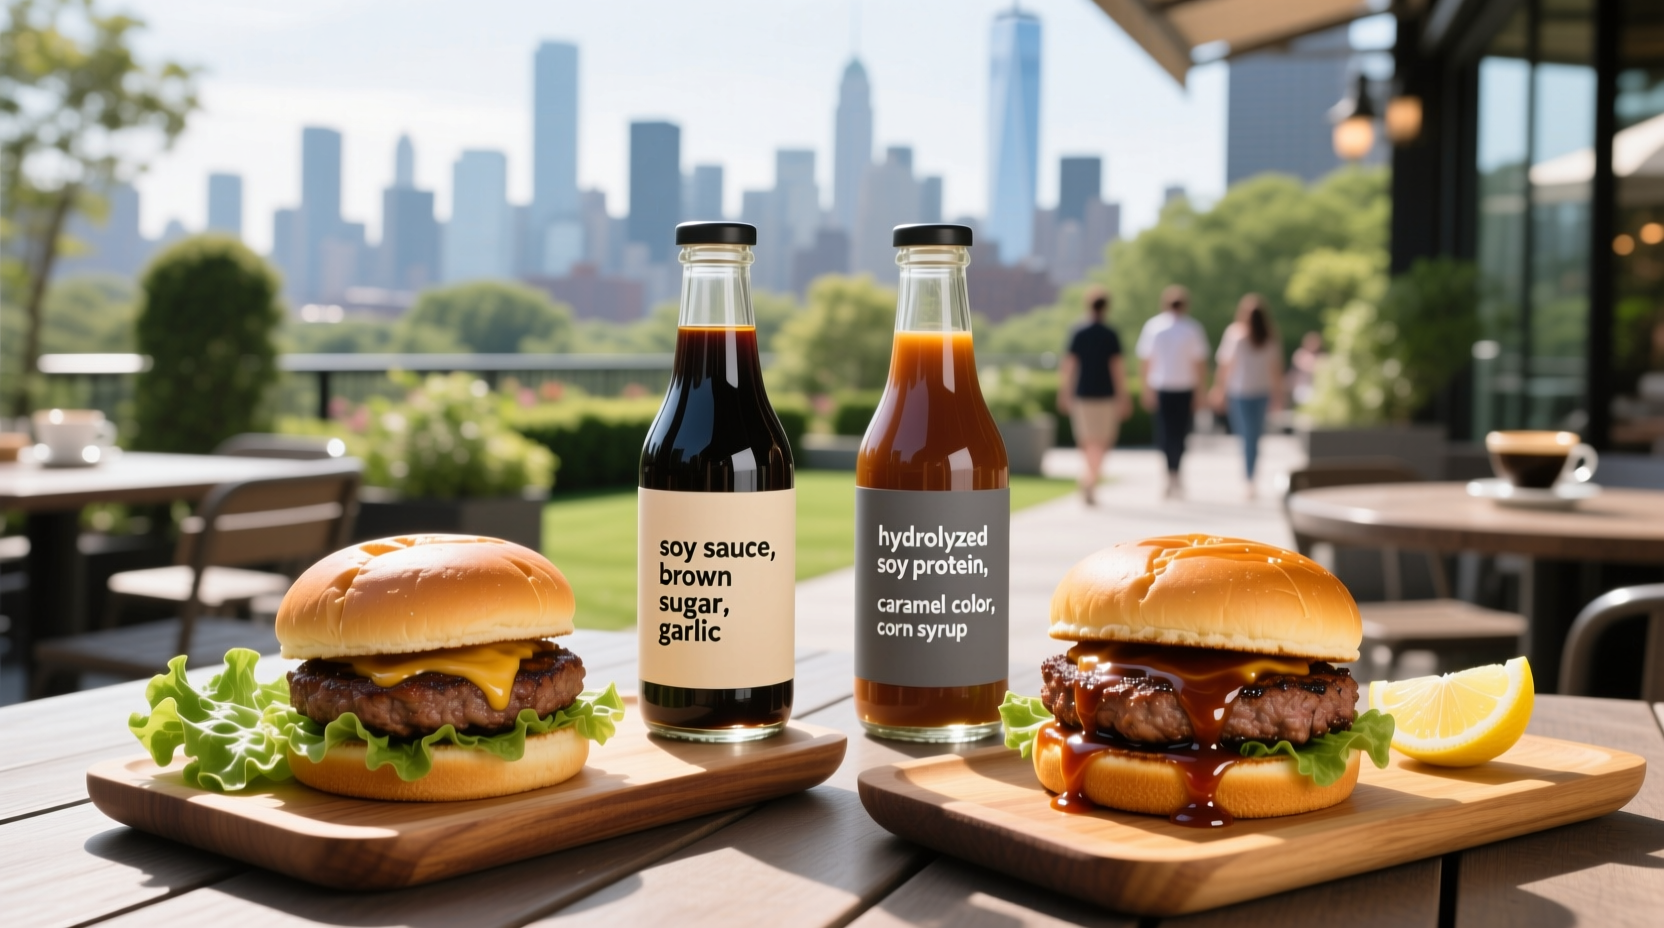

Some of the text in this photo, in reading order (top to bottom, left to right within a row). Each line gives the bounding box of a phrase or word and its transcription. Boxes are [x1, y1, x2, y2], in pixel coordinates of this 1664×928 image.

[878, 524, 988, 553] hydrolyzed
[659, 539, 776, 563] soy sauce,
[659, 562, 732, 587] brown
[877, 555, 989, 580] soy protein,
[659, 595, 730, 619] sugar,
[877, 594, 996, 615] caramel color,
[658, 618, 722, 646] garlic
[877, 620, 968, 643] corn syrup
